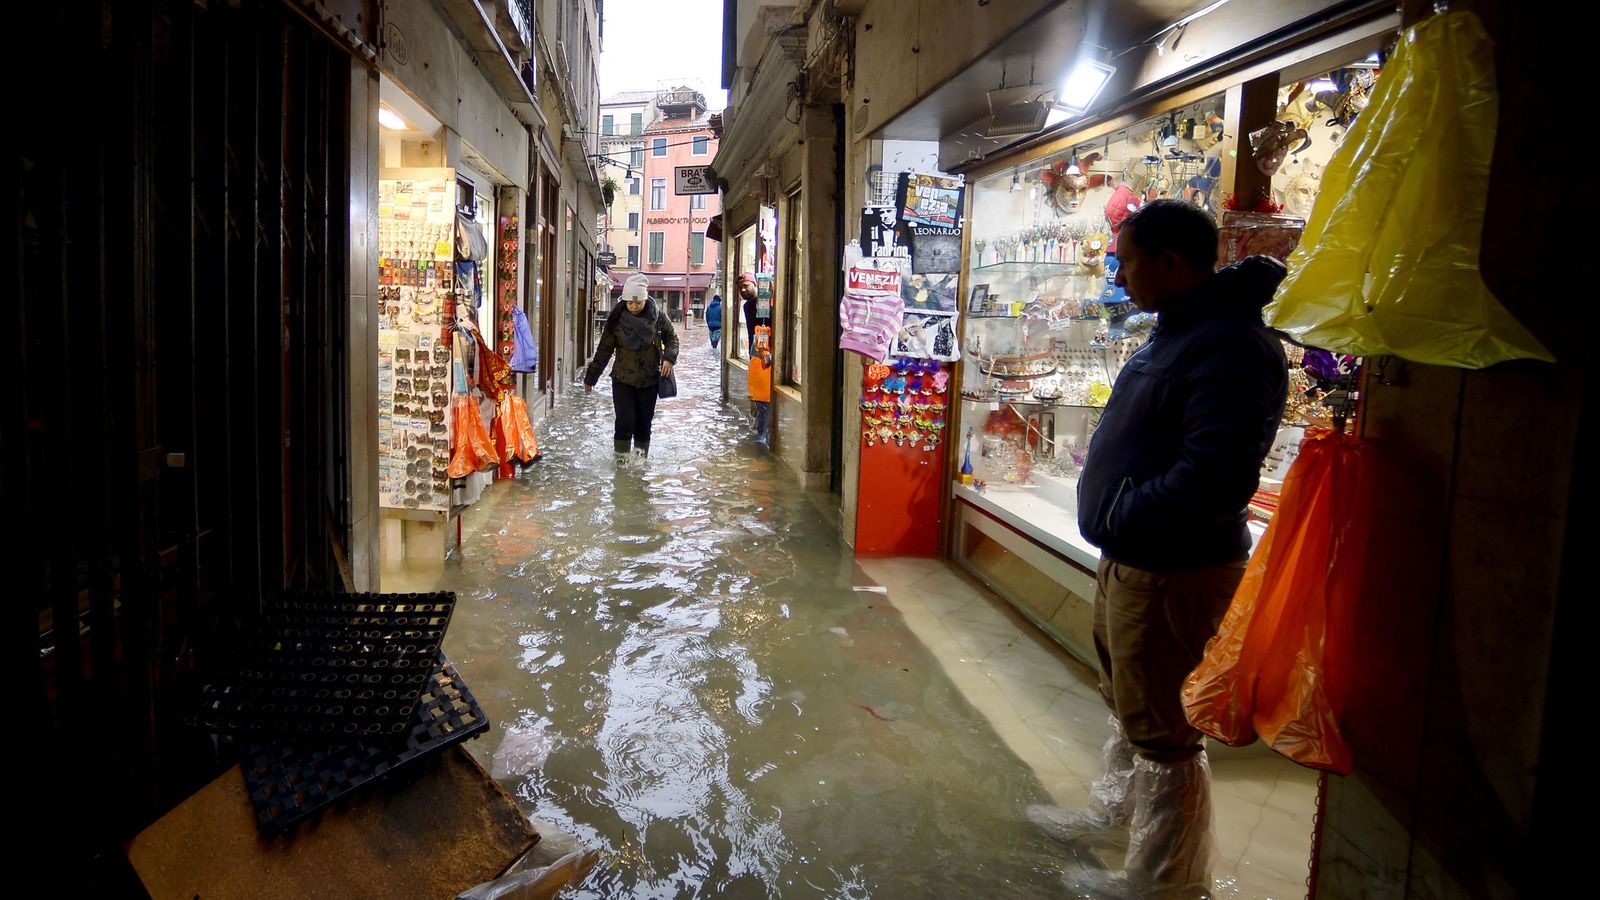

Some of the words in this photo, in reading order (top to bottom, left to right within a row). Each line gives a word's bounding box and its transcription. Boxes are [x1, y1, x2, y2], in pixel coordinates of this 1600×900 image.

[681, 167, 708, 178] BRA'S
[646, 217, 675, 225] ALBERGO
[683, 216, 708, 224] TIPOLO
[871, 225, 879, 240] il
[913, 227, 961, 236] LEONARDO
[871, 241, 908, 257] Padrino
[850, 271, 900, 285] VENEZIA
